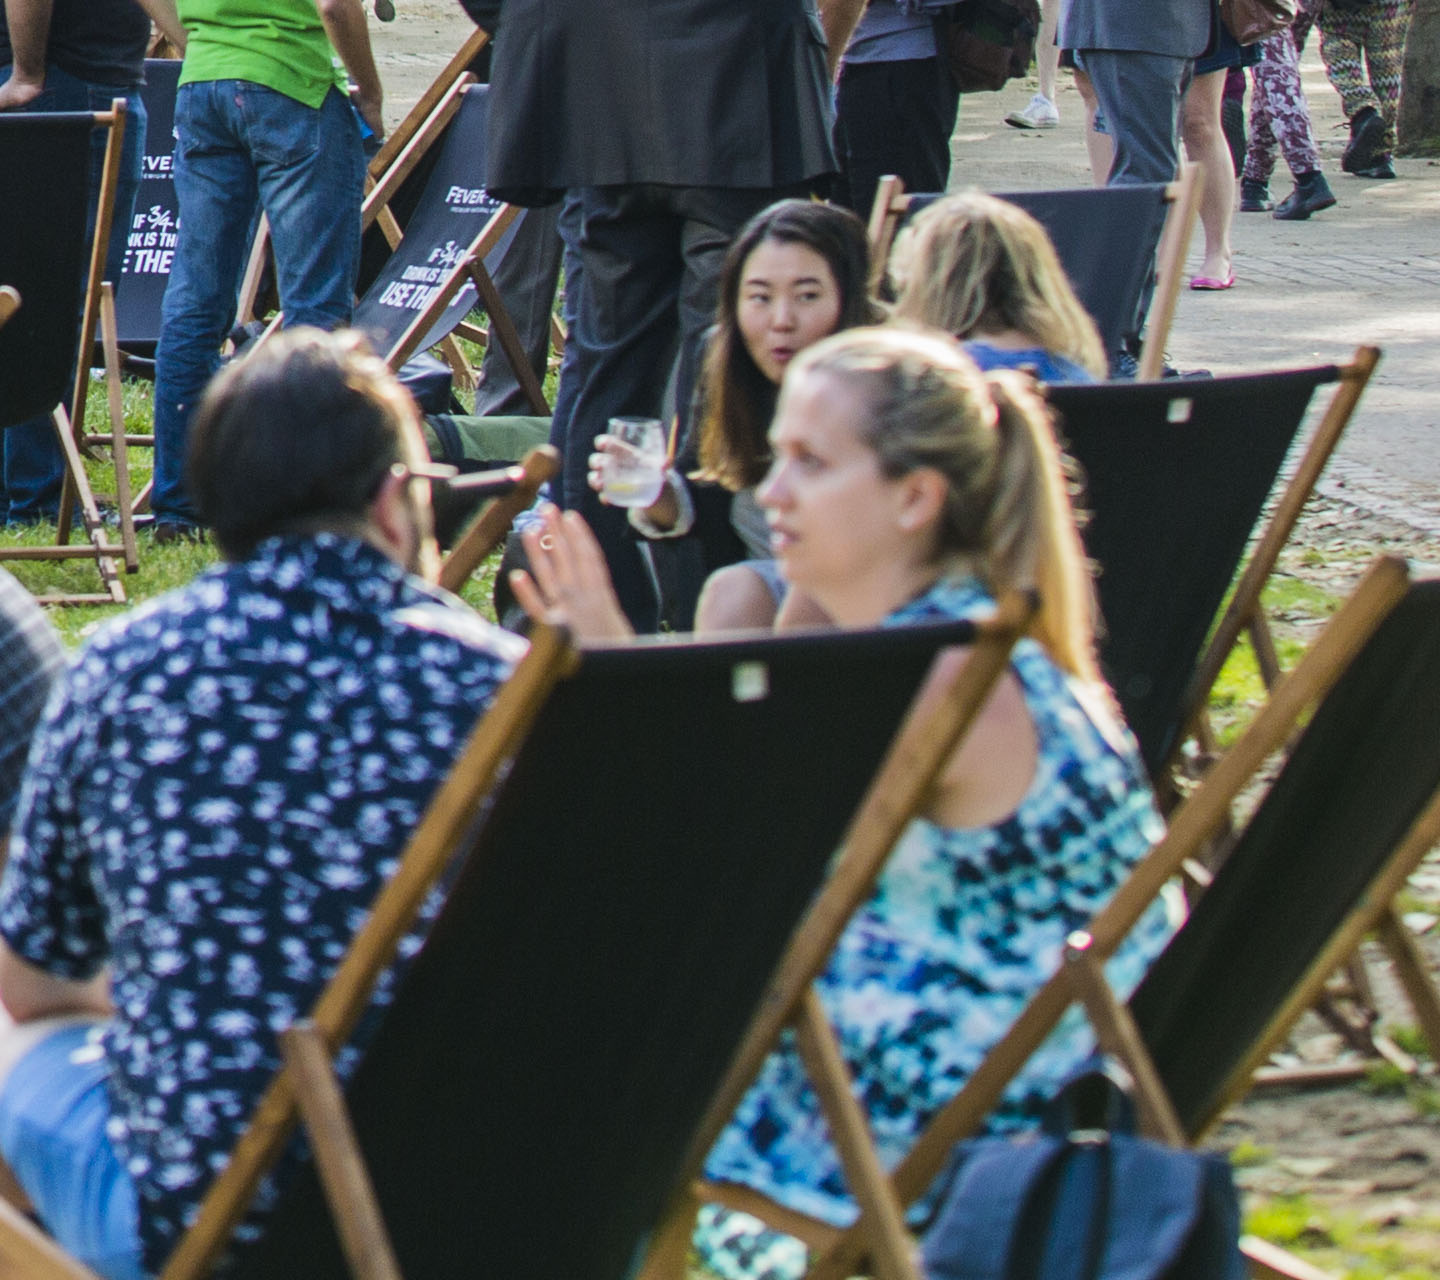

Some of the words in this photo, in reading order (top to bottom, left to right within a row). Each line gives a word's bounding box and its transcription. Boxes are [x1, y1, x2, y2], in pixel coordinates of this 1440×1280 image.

[133, 213, 147, 229] IF
[143, 232, 158, 247] IS
[134, 249, 176, 274] THE
[379, 281, 416, 307] USE
